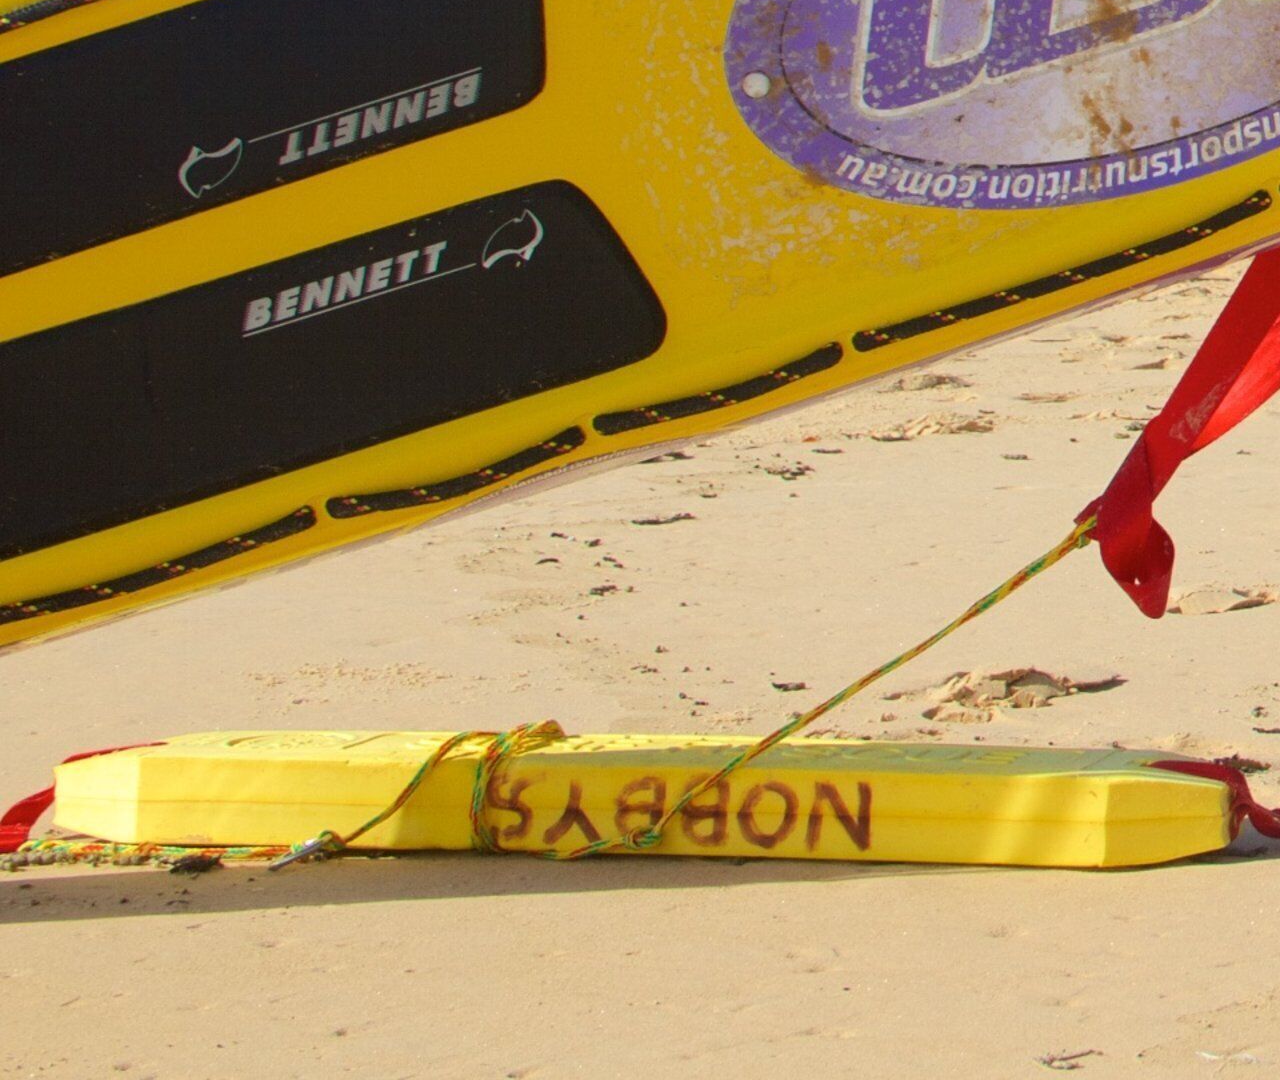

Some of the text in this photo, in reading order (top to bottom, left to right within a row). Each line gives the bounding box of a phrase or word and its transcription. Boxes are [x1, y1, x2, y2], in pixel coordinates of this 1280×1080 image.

[278, 72, 482, 166] BENNETT
[241, 240, 449, 332] BENNETT
[486, 770, 872, 853] NOBBYS
